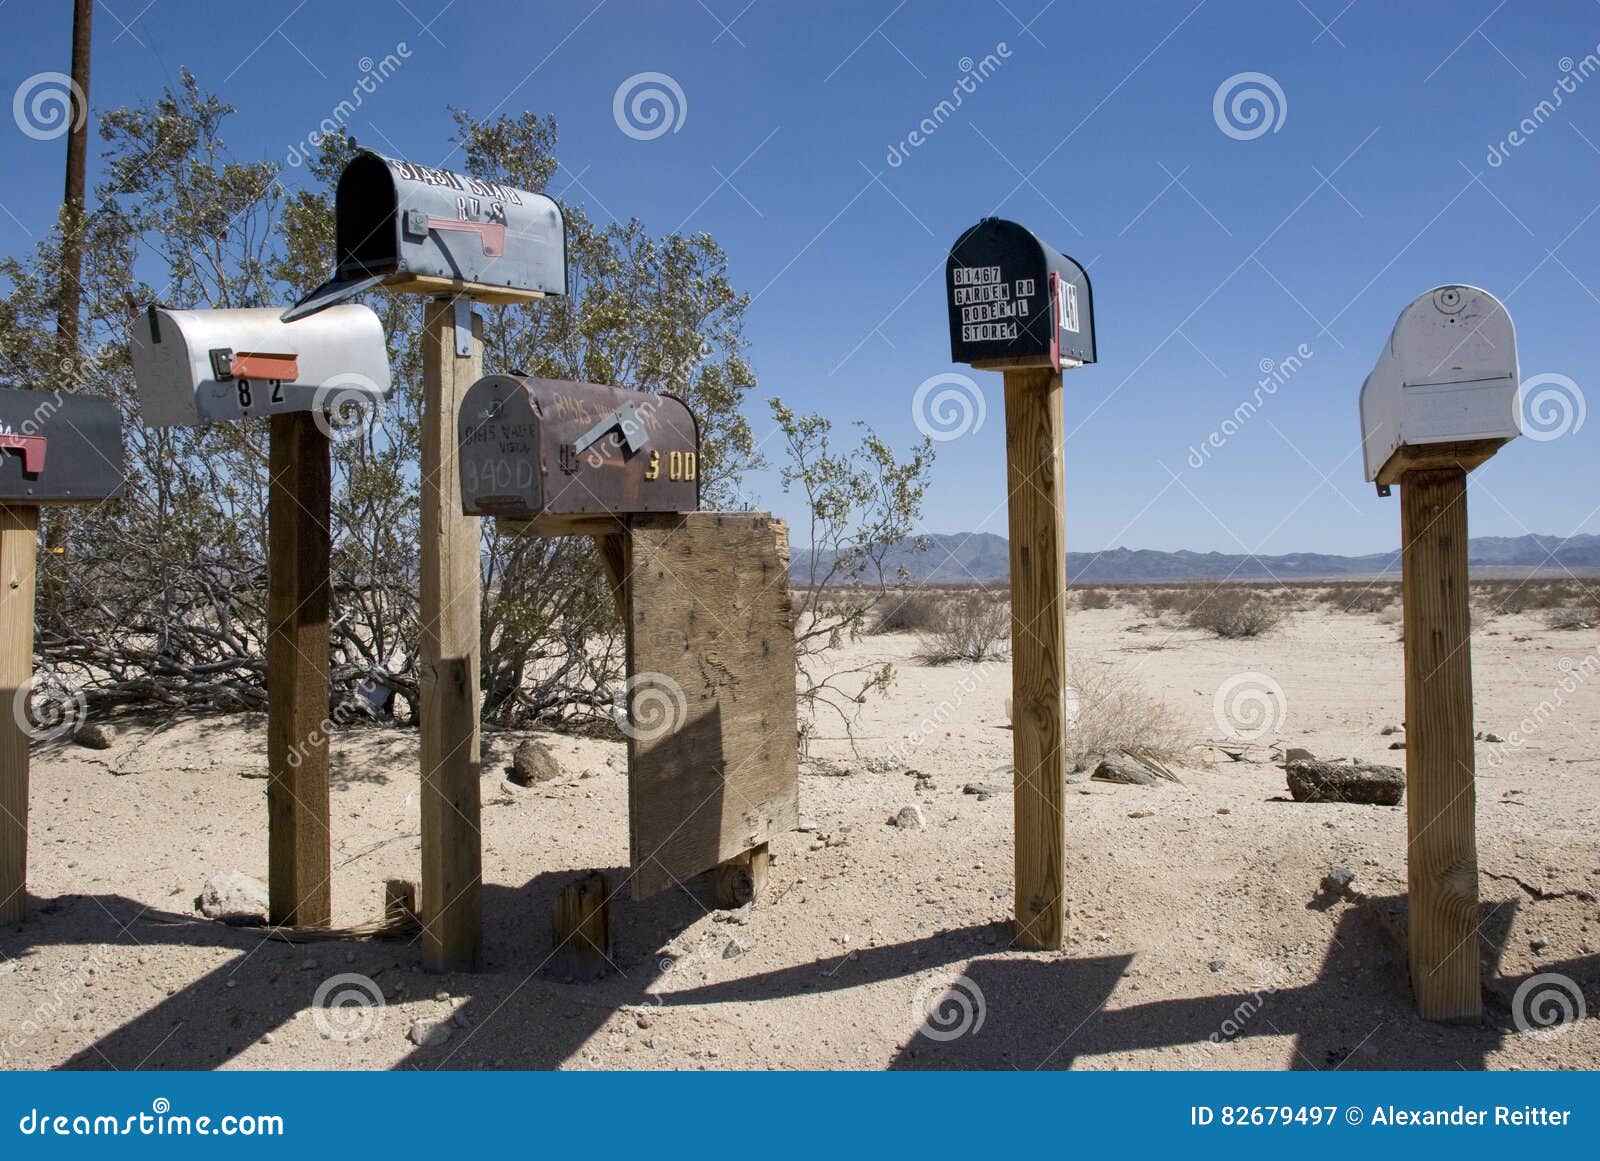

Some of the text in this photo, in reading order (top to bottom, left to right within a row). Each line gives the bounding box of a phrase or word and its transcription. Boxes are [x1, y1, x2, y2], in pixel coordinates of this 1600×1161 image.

[954, 267, 1001, 284] 81467
[956, 280, 1033, 304] GARDEN RD
[963, 300, 1029, 322] ROBERT L
